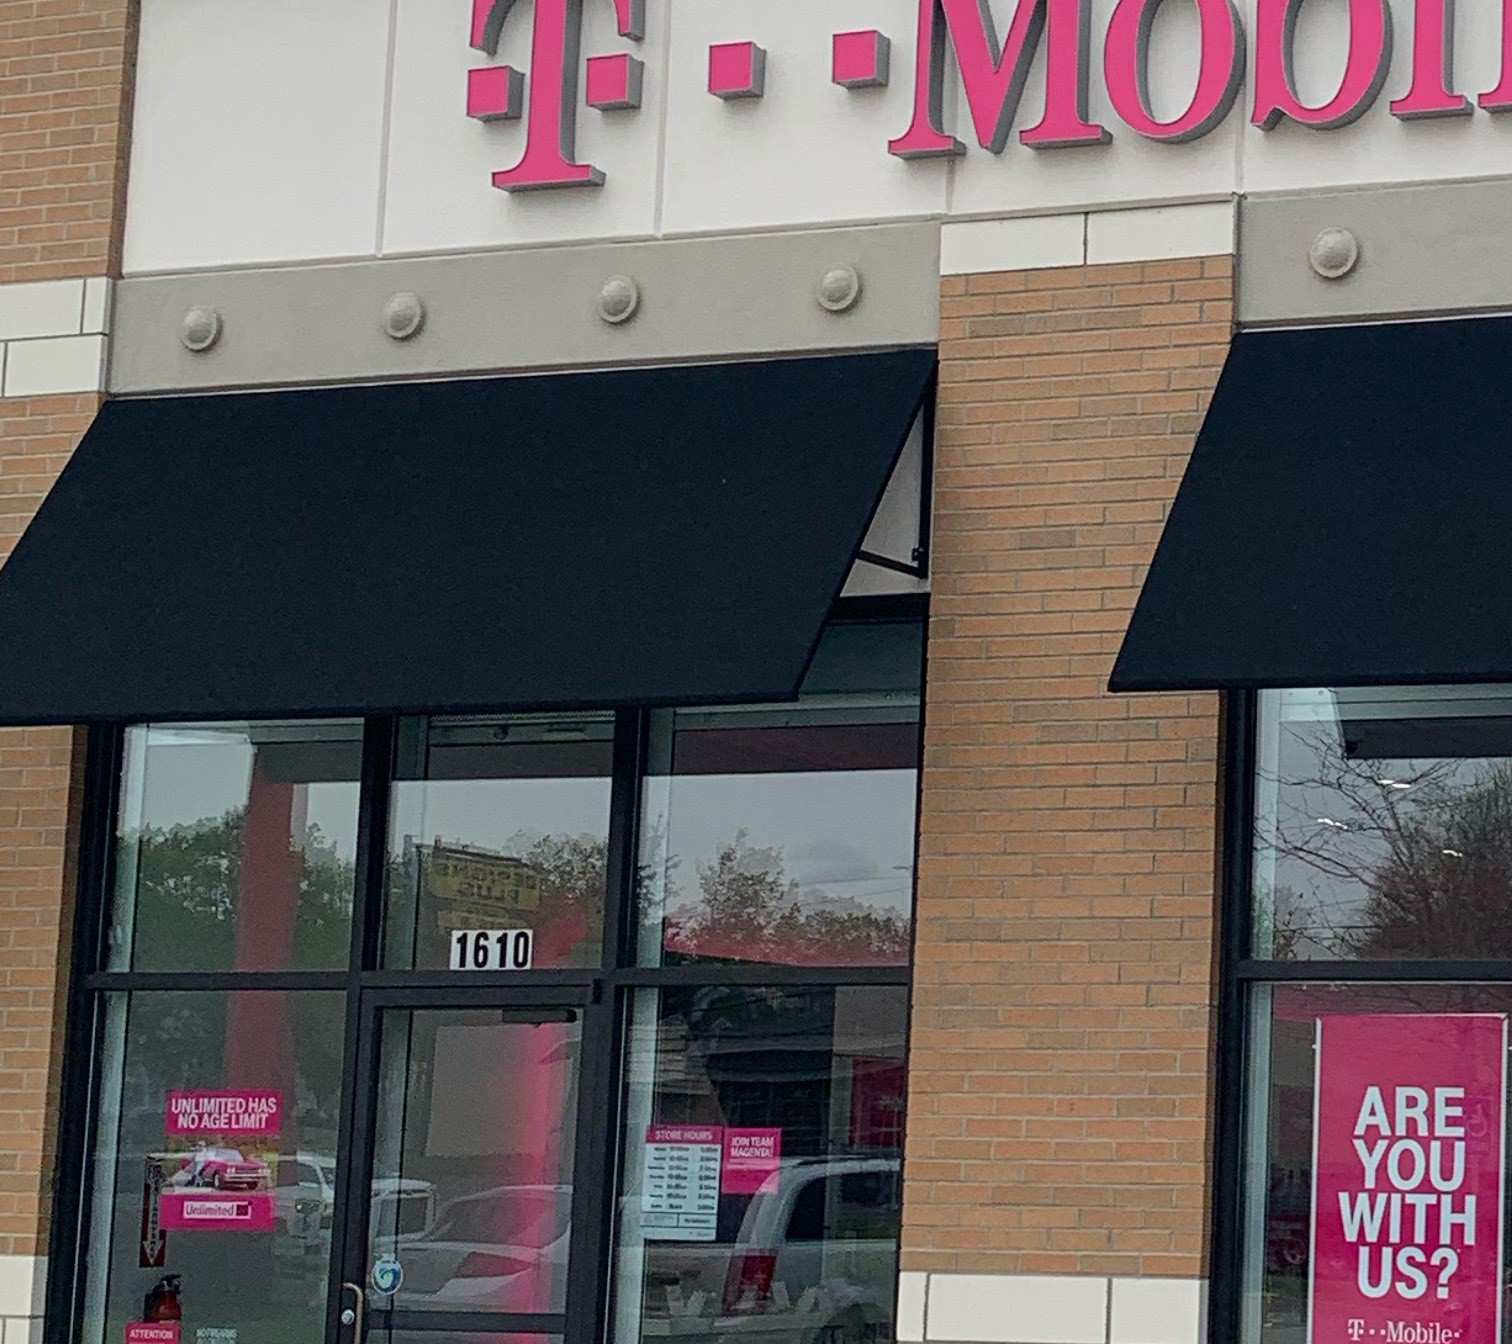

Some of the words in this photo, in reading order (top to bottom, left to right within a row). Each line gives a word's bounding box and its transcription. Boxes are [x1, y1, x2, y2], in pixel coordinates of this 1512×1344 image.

[456, 930, 530, 969] 1610
[171, 1098, 246, 1114] UNLIMITED
[248, 1097, 277, 1114] HAS
[1353, 1086, 1466, 1137] ARE
[177, 1114, 199, 1129] NO
[200, 1114, 229, 1129] AGE
[231, 1114, 269, 1129] LIMIT
[655, 1130, 682, 1141] STORE
[683, 1131, 713, 1142] HOURS
[751, 1136, 775, 1147] TEAM
[1352, 1138, 1466, 1192] YOU
[185, 1204, 234, 1217] Unlimited
[1338, 1191, 1477, 1246] WITH
[1357, 1245, 1460, 1300] US?
[129, 1328, 174, 1340] ATTENTION
